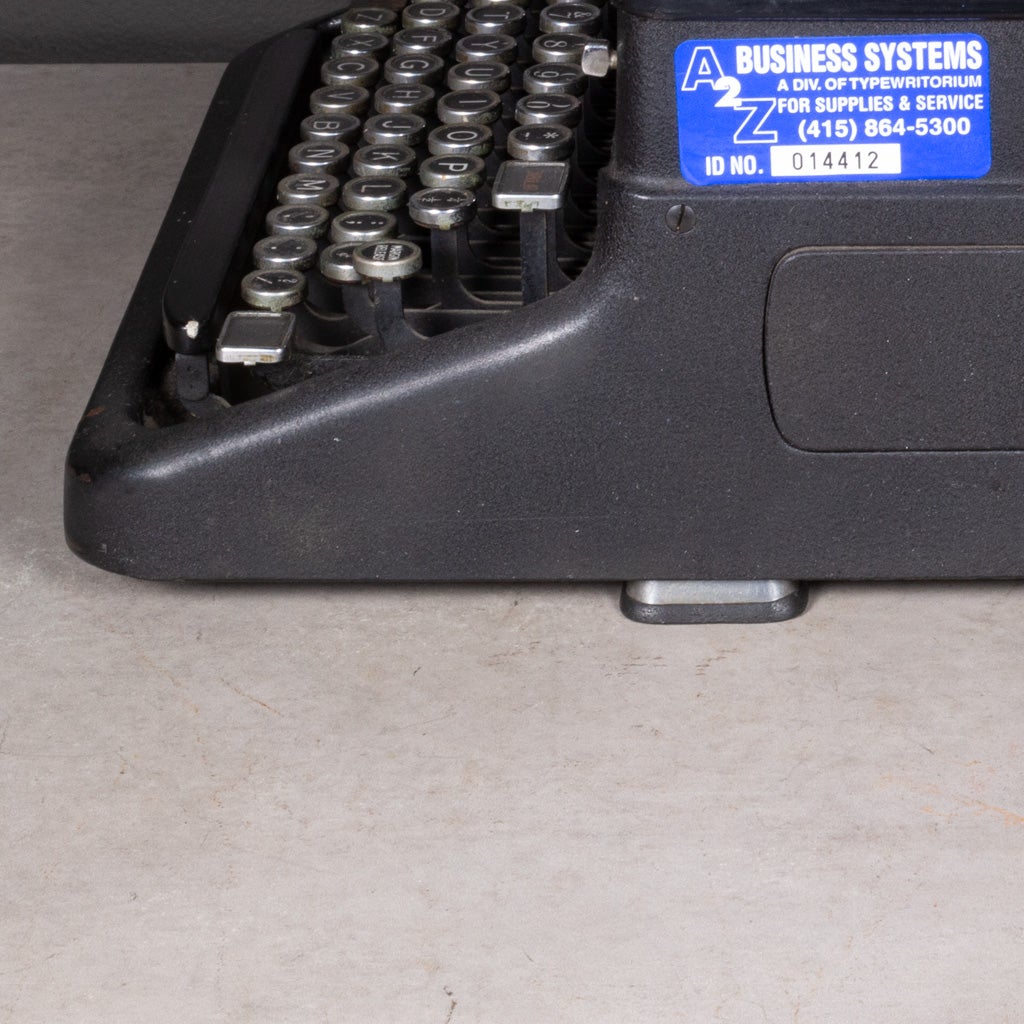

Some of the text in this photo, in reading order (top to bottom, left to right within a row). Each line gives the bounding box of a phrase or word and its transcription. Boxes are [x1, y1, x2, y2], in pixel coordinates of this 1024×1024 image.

[419, 8, 446, 17] D
[483, 11, 511, 20] T
[348, 39, 374, 47] X
[411, 35, 438, 43] F
[471, 39, 500, 49] Y
[543, 40, 568, 48] 8
[736, 40, 983, 75] BUSINESS SYSTEMS
[336, 61, 365, 71] C
[399, 59, 430, 69] G
[464, 67, 494, 77] U
[777, 75, 982, 92] A DIV. OF TYPEWRITORIUM
[327, 91, 354, 100] V
[392, 90, 422, 99] H
[777, 94, 984, 114] FOR SUPPLIES & SERVICE
[312, 120, 340, 130] B
[381, 120, 412, 129] J
[798, 117, 971, 143] (415) 864-5300
[304, 149, 335, 159] N
[372, 151, 400, 161] K
[438, 162, 469, 172] P
[705, 151, 879, 176] ID NO. 014412
[295, 179, 327, 191] M
[360, 184, 393, 193] L
